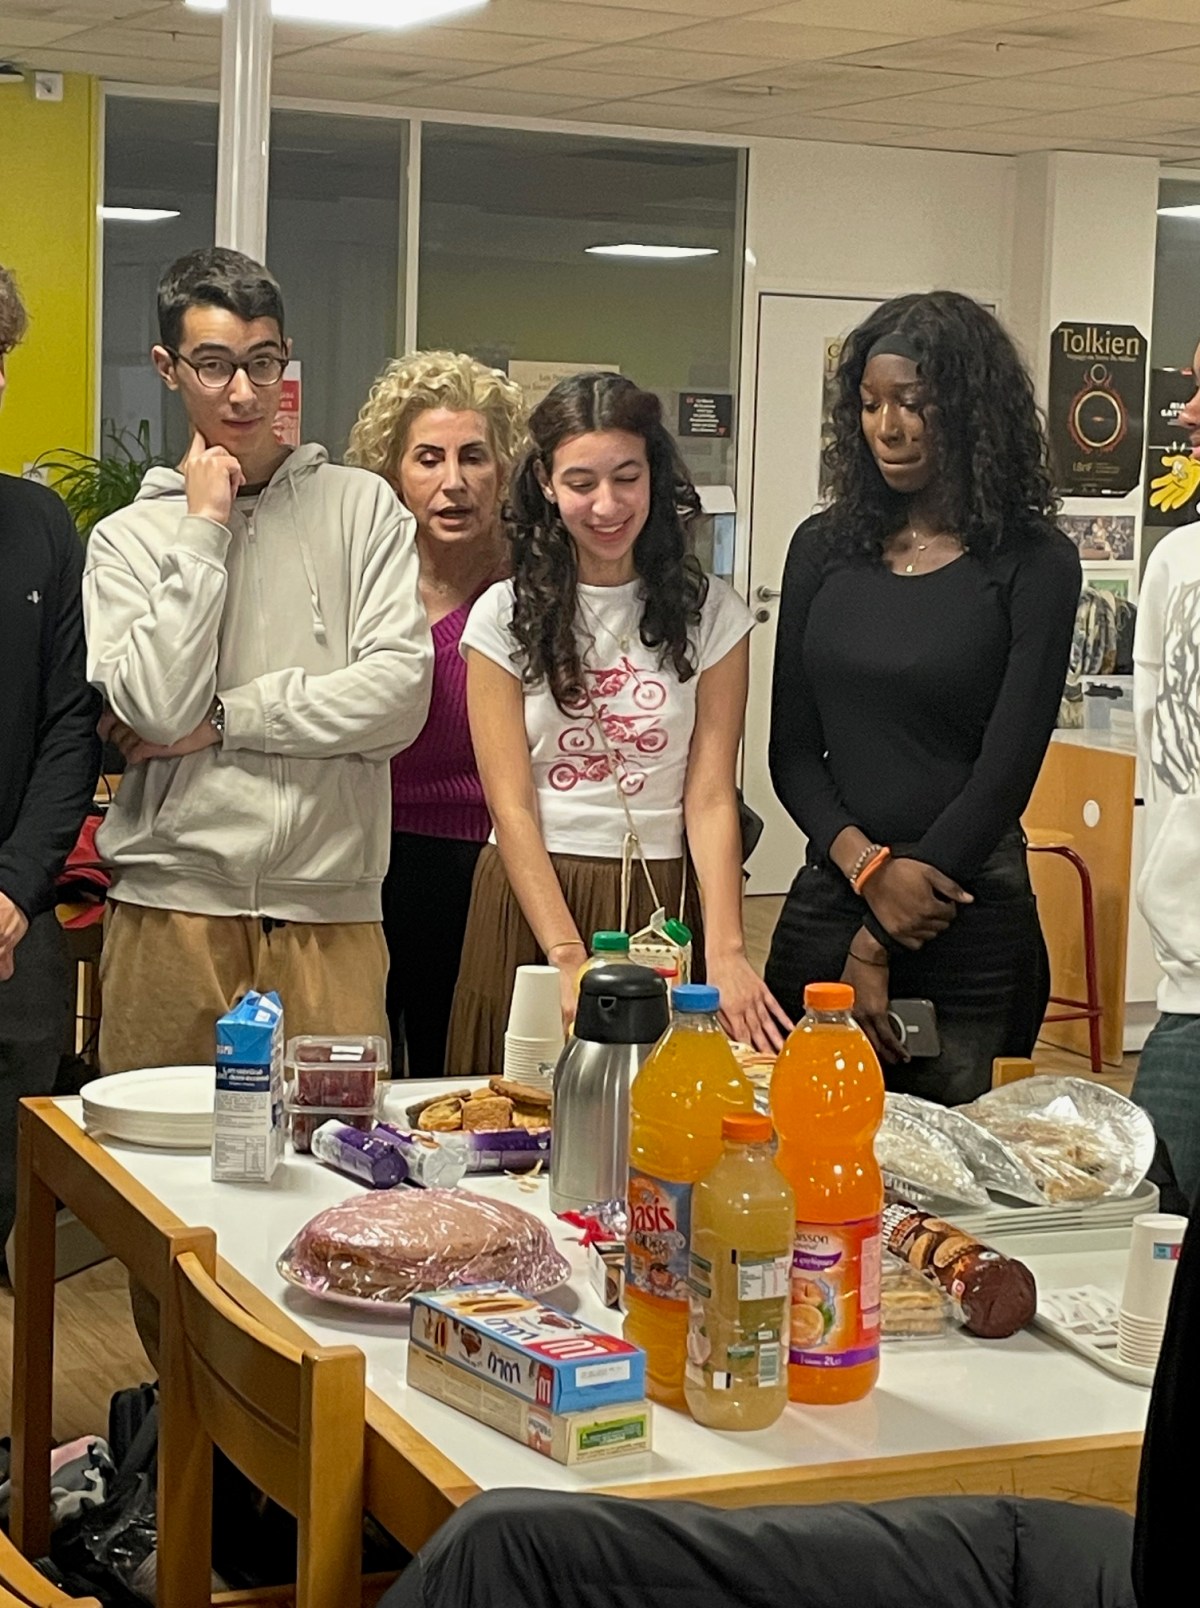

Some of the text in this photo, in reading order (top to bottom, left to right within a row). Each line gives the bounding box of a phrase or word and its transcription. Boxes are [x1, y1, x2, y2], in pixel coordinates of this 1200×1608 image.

[1058, 327, 1140, 356] Tolkien
[540, 1340, 609, 1359] LU
[488, 1351, 521, 1384] LULU
[538, 1376, 551, 1404] LU
